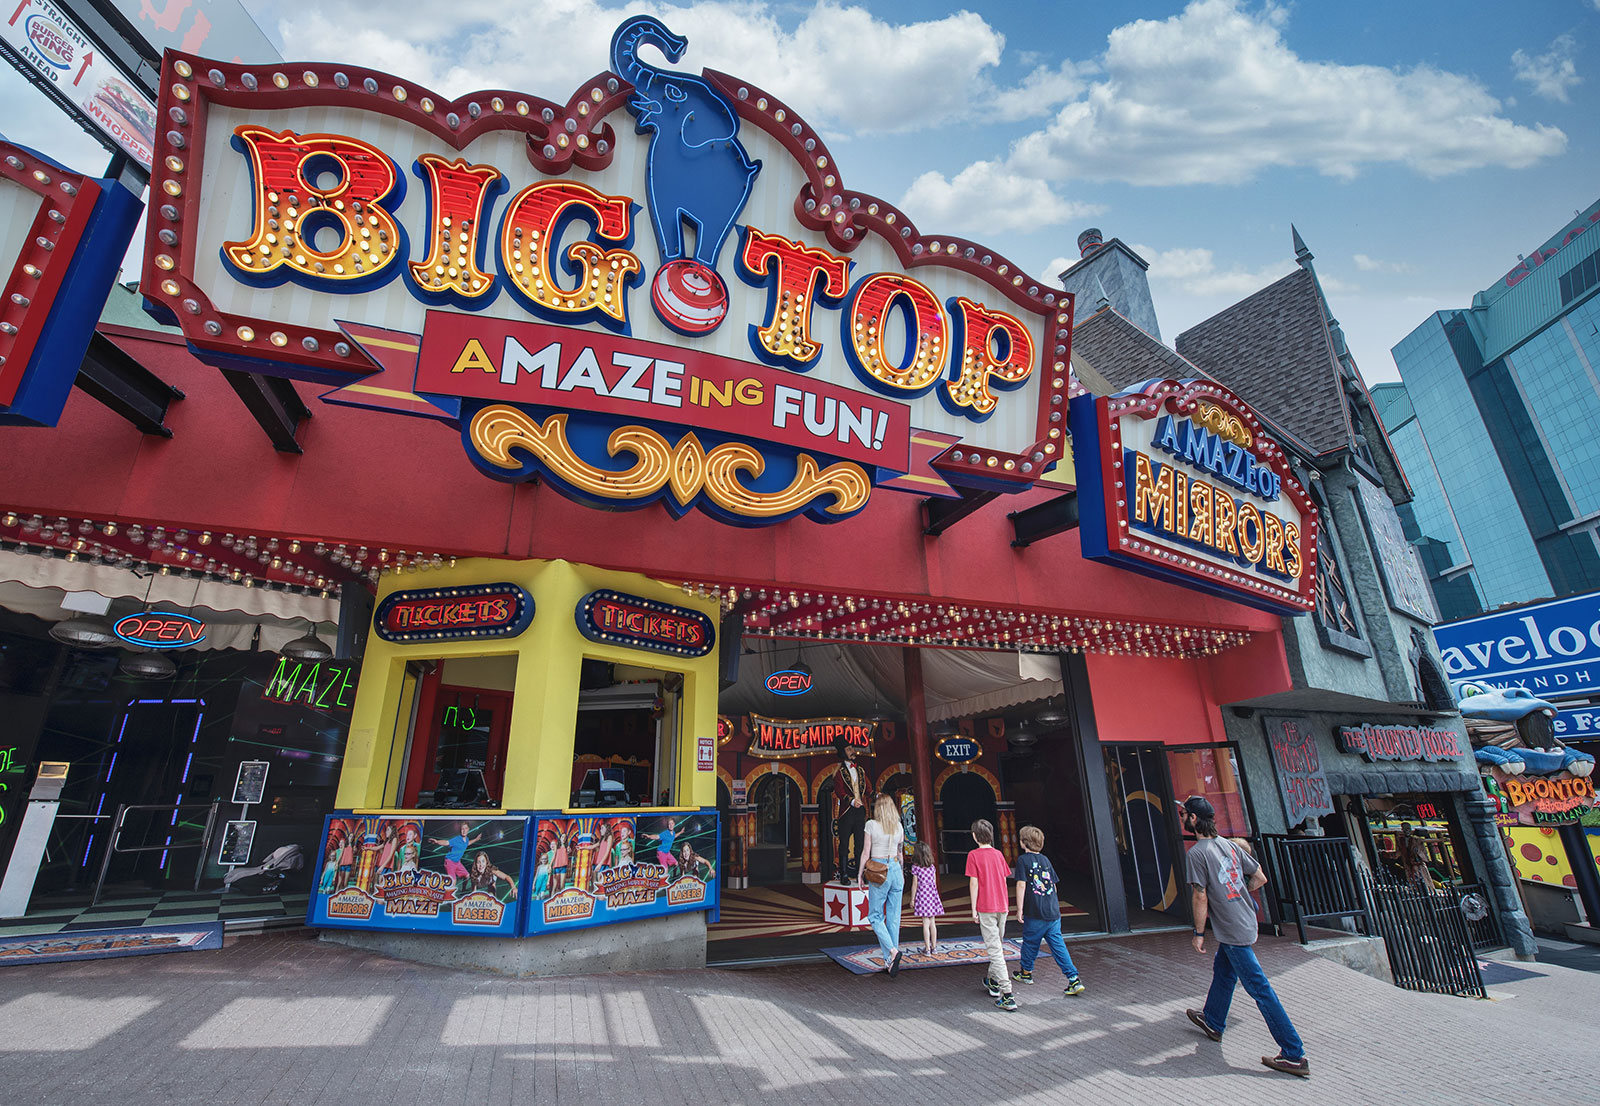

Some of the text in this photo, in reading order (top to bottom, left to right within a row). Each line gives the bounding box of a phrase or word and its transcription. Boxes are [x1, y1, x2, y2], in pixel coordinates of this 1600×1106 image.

[30, 30, 74, 64] KING
[31, 21, 75, 55] BURGER
[20, 45, 59, 82] AHEAD
[220, 125, 1036, 417] BIG TOP
[773, 384, 889, 451] FUN!
[1180, 418, 1257, 493] MAZE
[1257, 467, 1281, 501] OF
[396, 599, 509, 629] TICKETS
[602, 604, 701, 644] TICKETS
[117, 618, 205, 640] OPEN
[265, 658, 353, 708] MAZE
[766, 675, 812, 690] OPEN
[759, 723, 800, 750] MAZE
[800, 730, 808, 745] of
[1343, 726, 1465, 760] THE HAUNTED HOUSE
[945, 743, 971, 757] EXIT
[1283, 773, 1330, 818] HOUSE
[1416, 803, 1438, 819] OPEN
[1535, 805, 1591, 824] PLAYLAND
[383, 870, 453, 891] BIG TOP
[602, 863, 666, 886] BIG TOP
[386, 888, 408, 898] AMAZING
[605, 883, 627, 894] AMAZING
[607, 889, 655, 908] MAZE
[671, 889, 702, 901] LASERS
[331, 902, 369, 915] MIRRORS
[386, 900, 438, 915] MAZE
[457, 909, 499, 921] LASERS
[549, 902, 591, 917] MIRRORS
